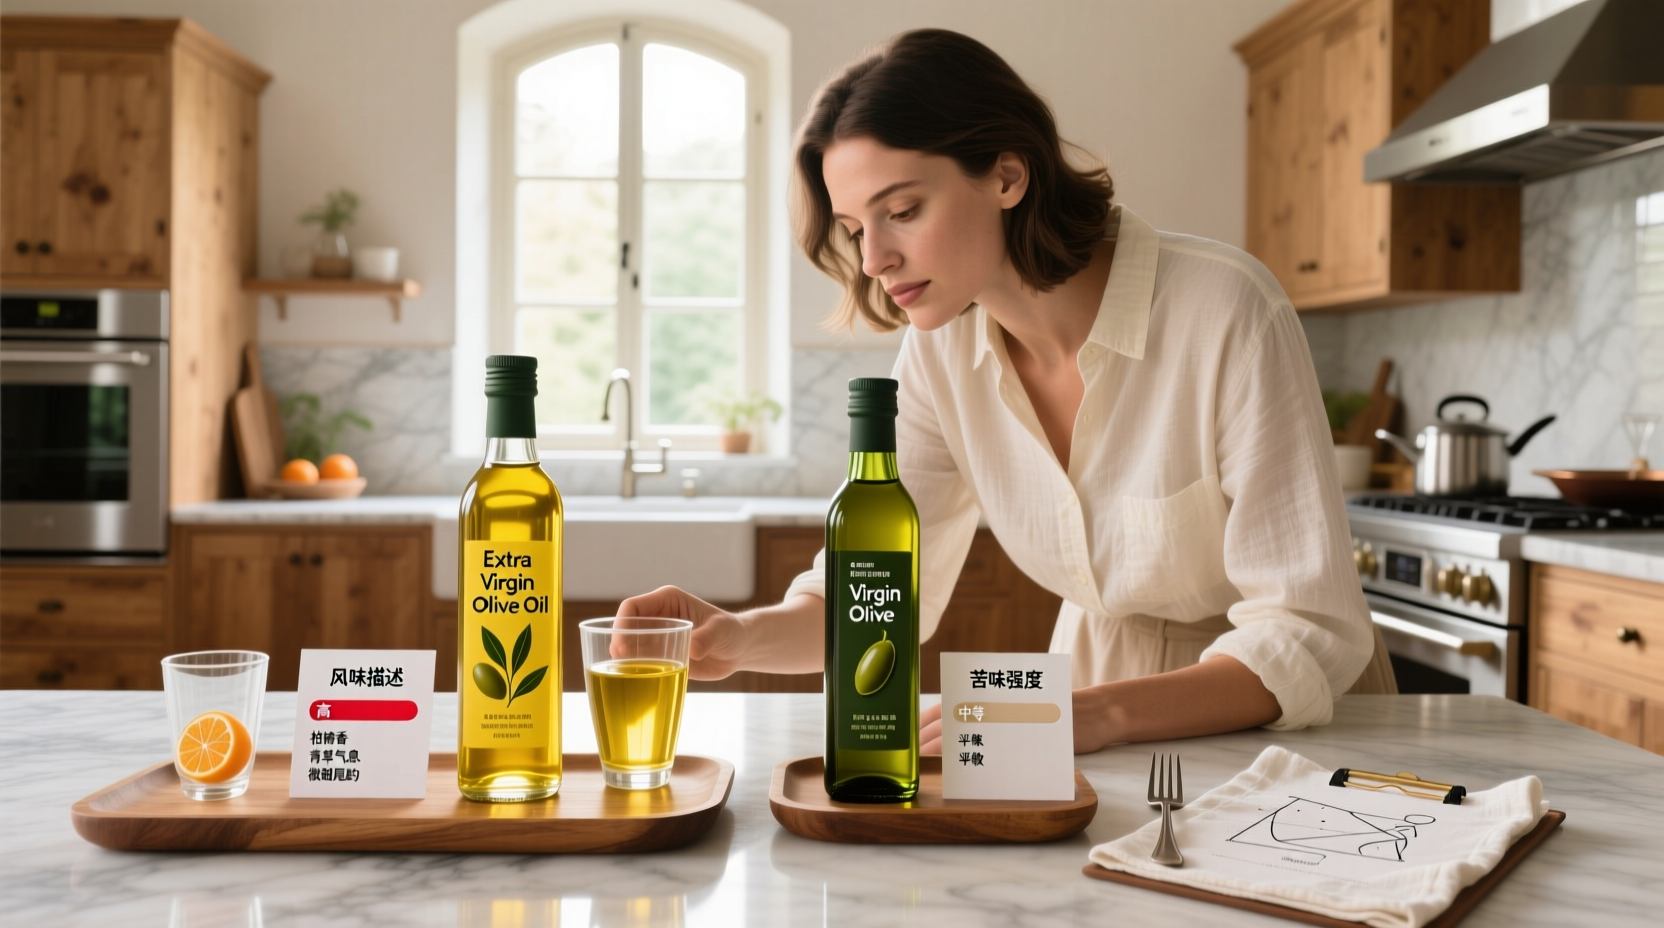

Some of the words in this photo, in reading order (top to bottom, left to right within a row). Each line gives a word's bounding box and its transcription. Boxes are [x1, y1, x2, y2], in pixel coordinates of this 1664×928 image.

[484, 550, 531, 568] Extra
[480, 573, 534, 596] Virgin
[849, 583, 901, 606] Virgin
[472, 595, 519, 613] Olive
[523, 595, 548, 613] Oil
[849, 605, 894, 622] Olive
[330, 667, 404, 687] 风味描述
[970, 669, 1043, 689] 苦味强度
